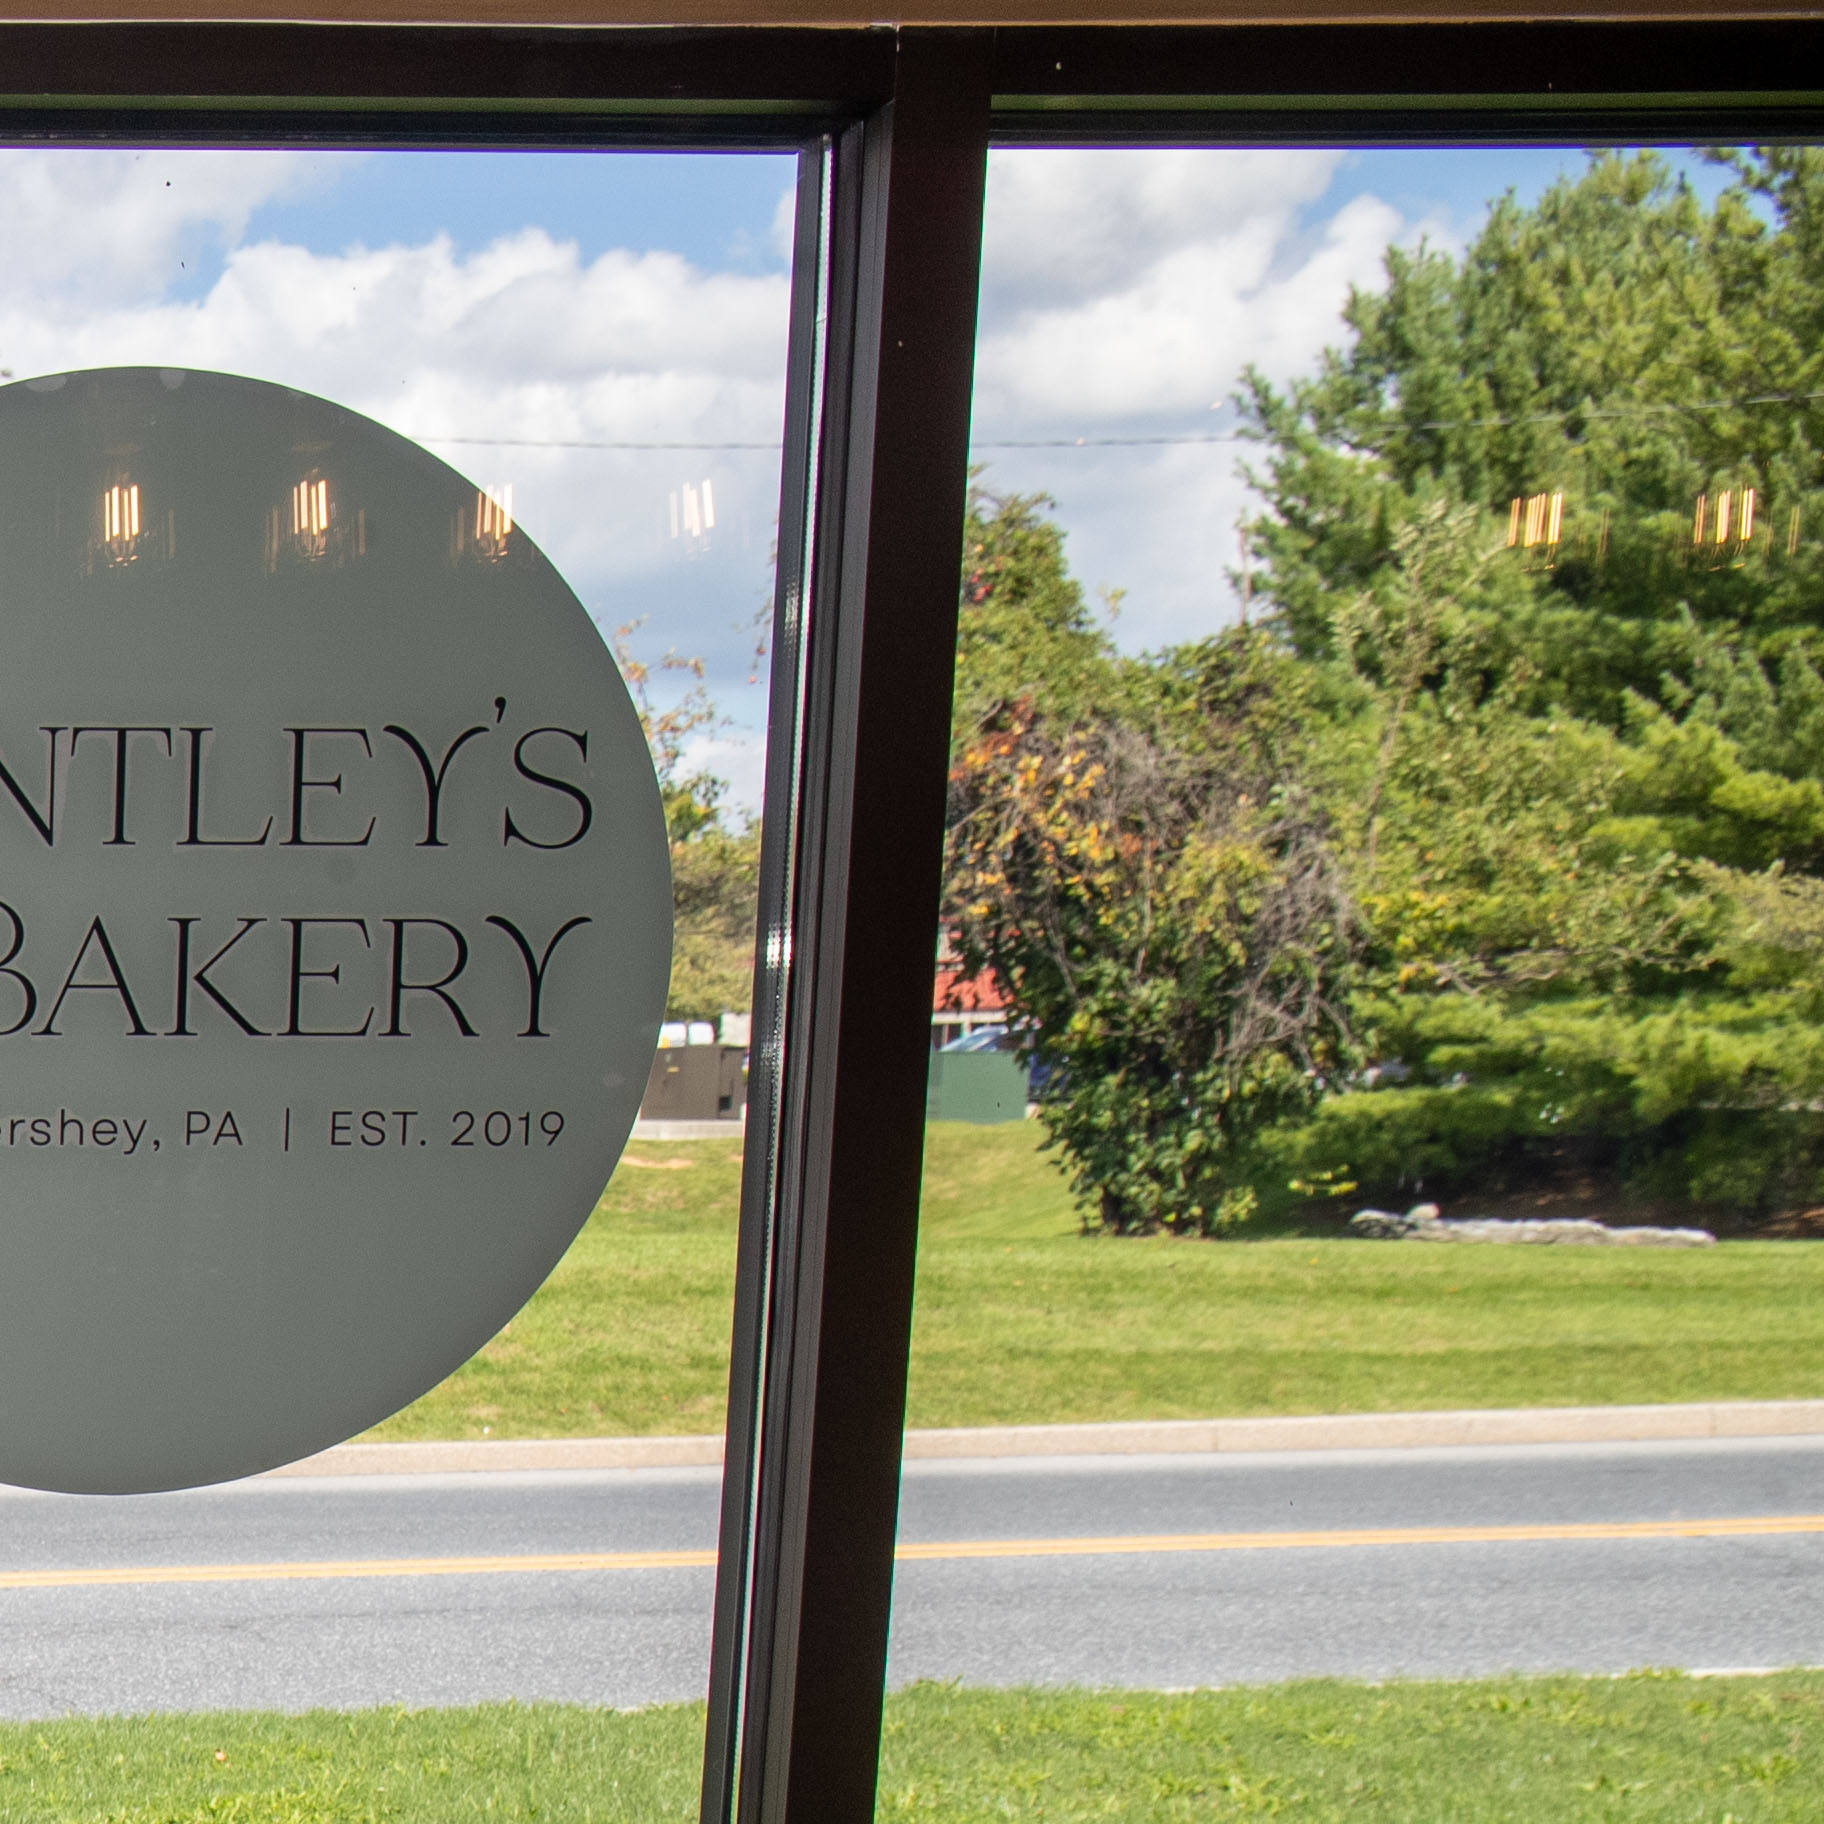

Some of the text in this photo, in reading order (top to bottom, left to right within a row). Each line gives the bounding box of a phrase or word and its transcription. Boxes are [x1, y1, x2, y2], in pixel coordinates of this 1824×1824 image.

[184, 1110, 245, 1147] PA
[329, 1110, 428, 1147] EST.
[450, 1109, 566, 1147] 2019
